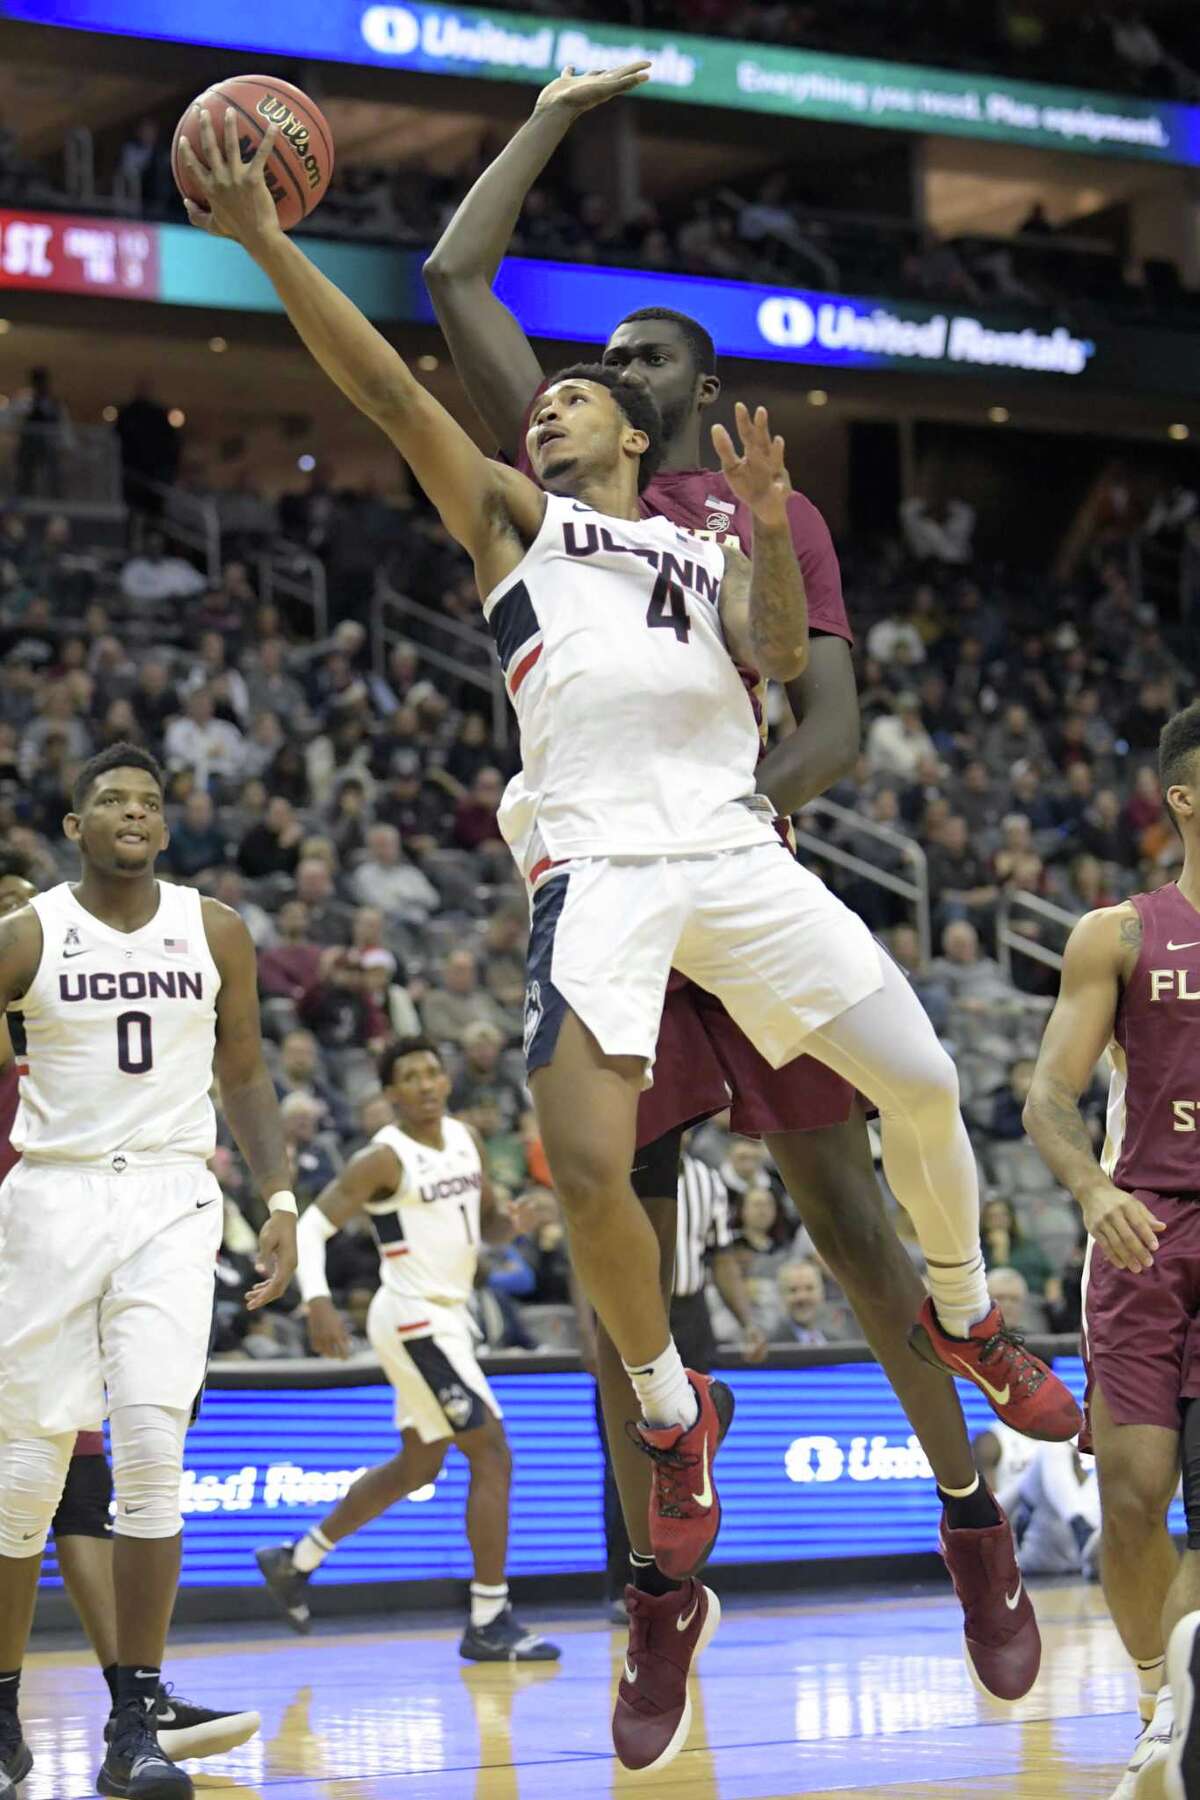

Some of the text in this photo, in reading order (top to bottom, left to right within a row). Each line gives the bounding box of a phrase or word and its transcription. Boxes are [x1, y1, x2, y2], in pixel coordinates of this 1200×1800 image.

[421, 14, 695, 86] United Rentals
[737, 61, 868, 112] Everything
[256, 93, 321, 190] Wilson
[817, 303, 1085, 375] United Rentals
[646, 572, 691, 644] 4
[59, 971, 203, 1002] UCONN
[117, 1011, 153, 1075] 0
[1172, 1100, 1200, 1132] S
[459, 1203, 474, 1245] 1
[848, 1434, 936, 1481] Uni
